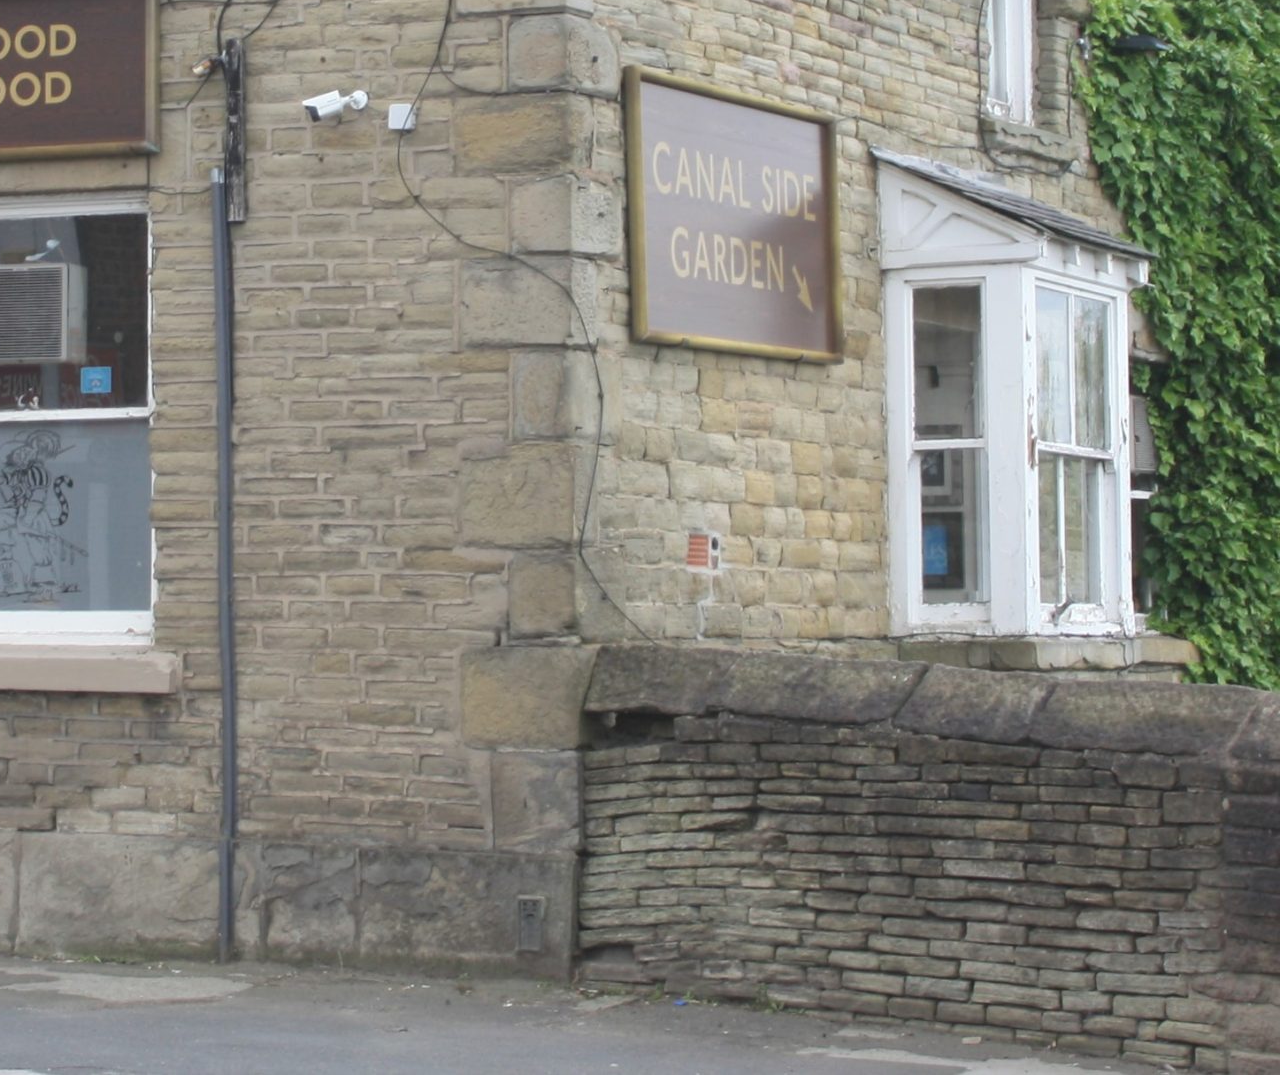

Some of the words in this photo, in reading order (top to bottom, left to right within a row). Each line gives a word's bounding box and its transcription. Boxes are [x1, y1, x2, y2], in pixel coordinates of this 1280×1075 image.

[653, 141, 752, 209] CANAL
[761, 165, 817, 222] SIDE
[671, 227, 785, 293] GARDEN
